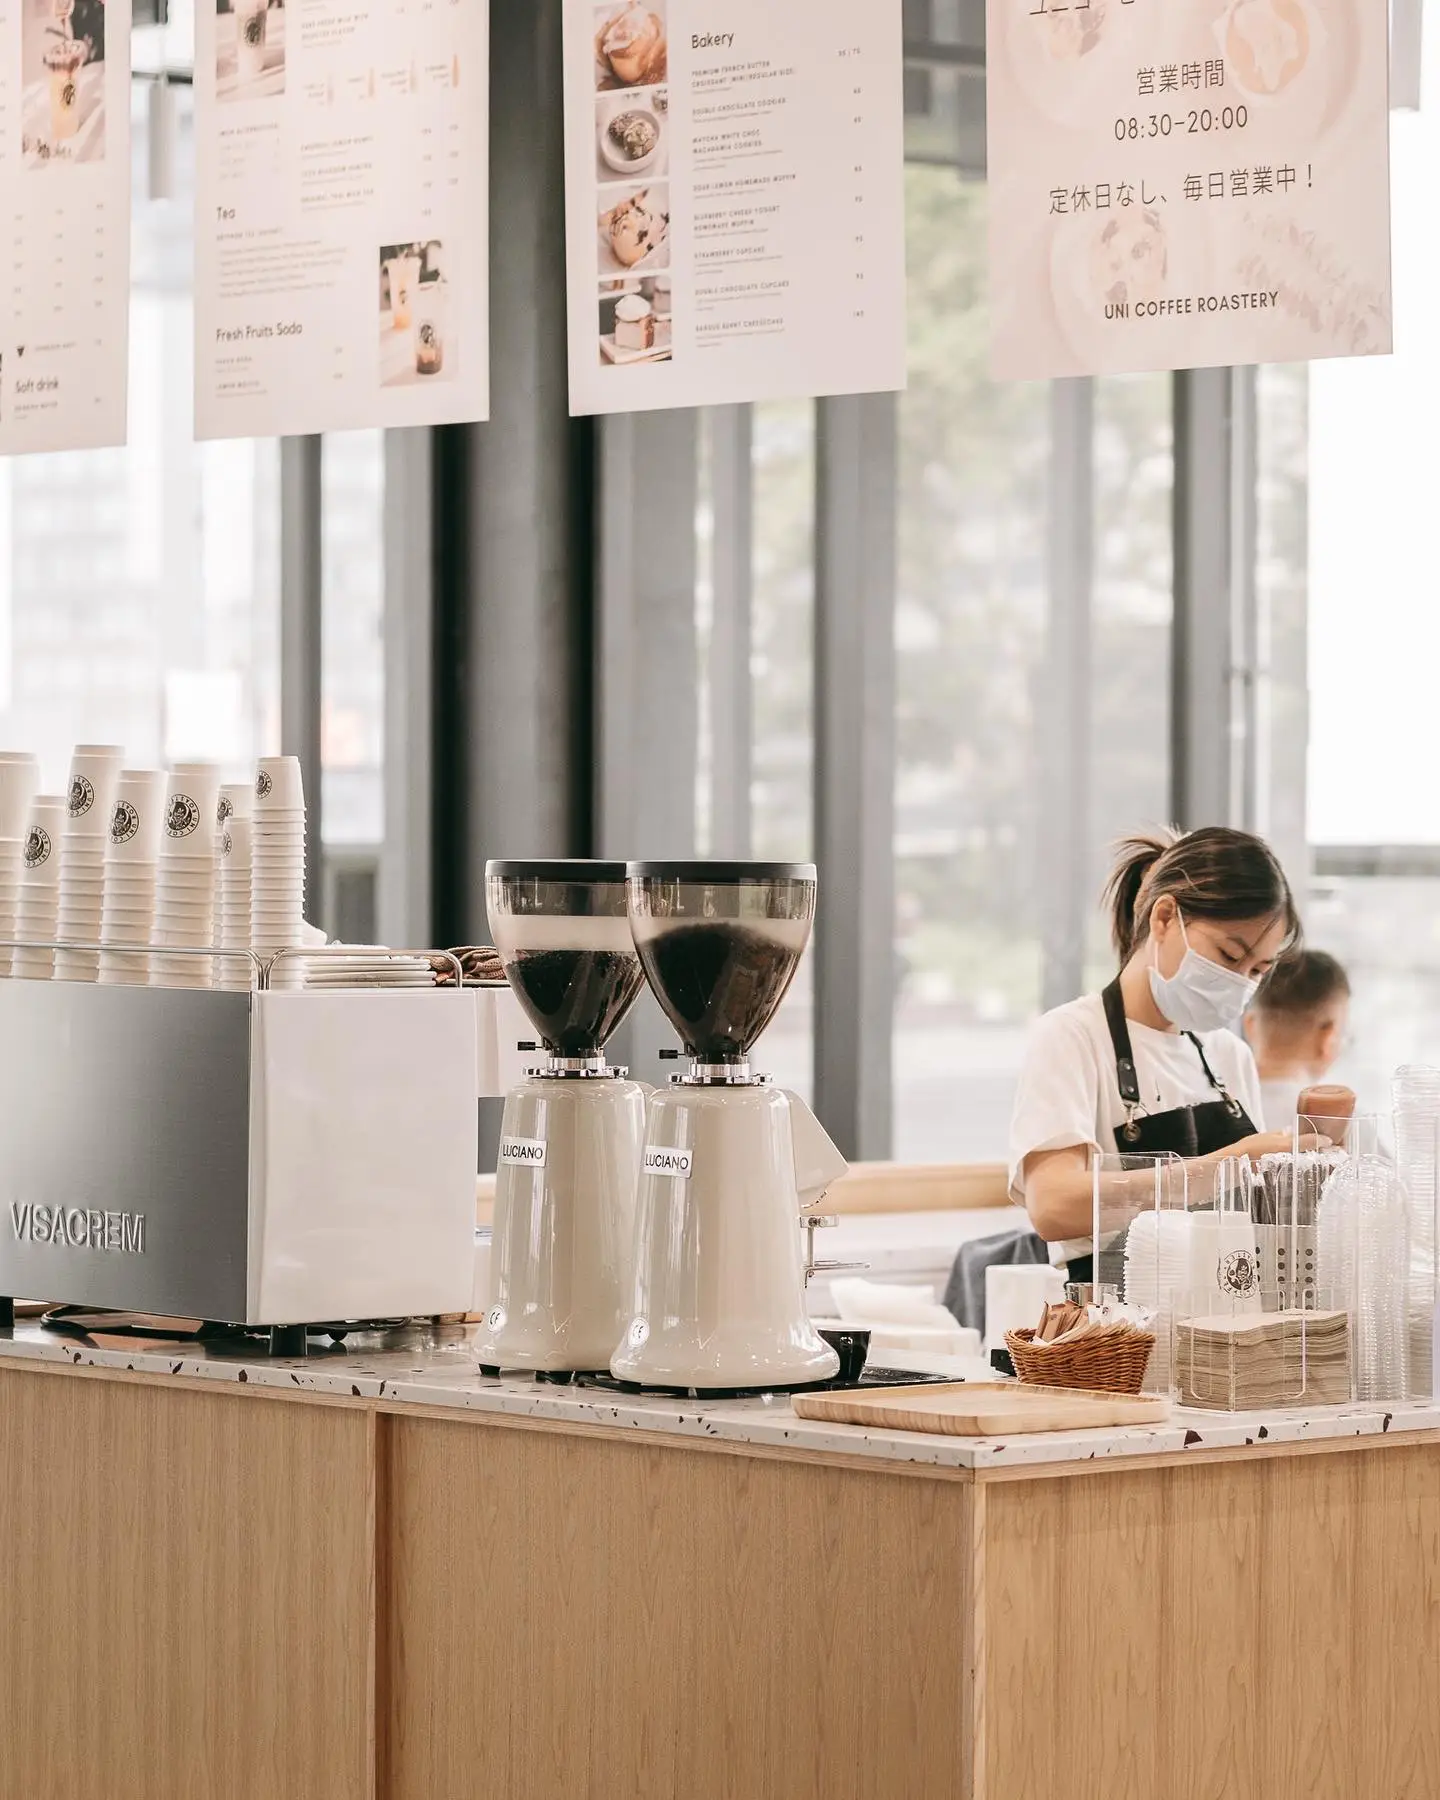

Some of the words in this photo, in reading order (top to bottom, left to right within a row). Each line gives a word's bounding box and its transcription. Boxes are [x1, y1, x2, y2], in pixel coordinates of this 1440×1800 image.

[691, 32, 735, 49] Bakery
[1136, 59, 1225, 96] 営業時間
[1114, 105, 1248, 141] 08:30-20:00
[217, 206, 235, 221] Tea
[1104, 303, 1130, 320] UNI
[1134, 298, 1192, 318] COFFEE
[1198, 291, 1279, 312] ROASTERY
[216, 326, 244, 343] Fresh
[246, 323, 273, 339] Fruits
[276, 321, 303, 335] Soda
[15, 379, 34, 394] Soft
[36, 377, 59, 392] drink
[502, 1144, 543, 1160] LUCIANO
[645, 1154, 689, 1170] LUCIANO
[11, 1202, 145, 1253] VISACREM
